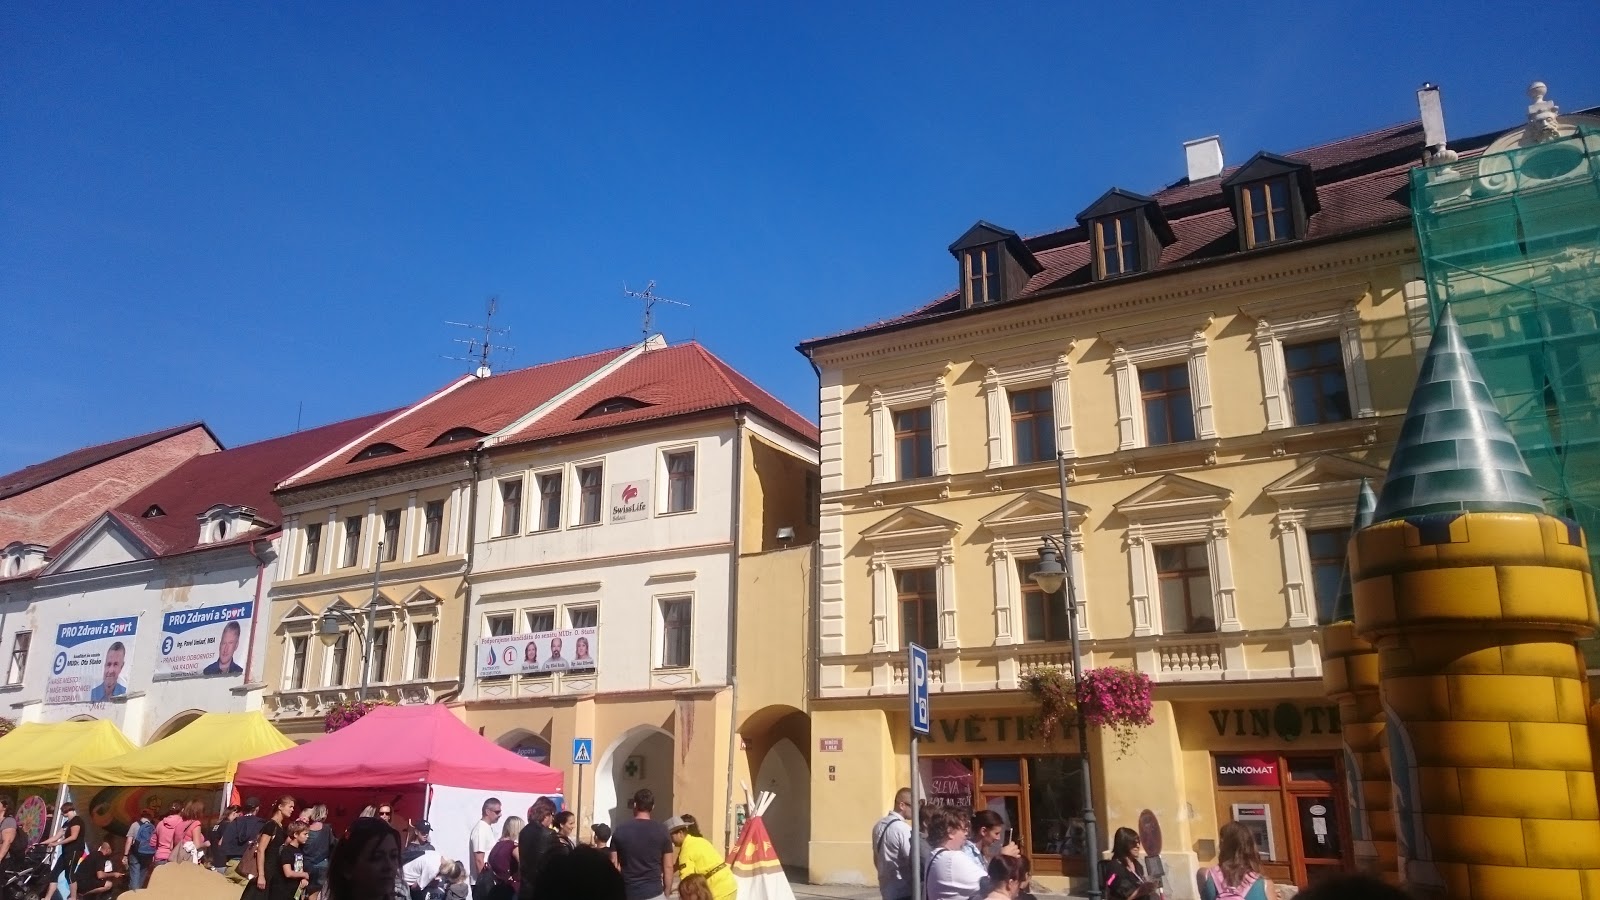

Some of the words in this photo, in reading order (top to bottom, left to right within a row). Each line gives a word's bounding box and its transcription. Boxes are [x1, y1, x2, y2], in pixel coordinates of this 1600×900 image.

[169, 614, 186, 626] PRO
[186, 609, 214, 624] Zdraví
[214, 611, 219, 620] a
[61, 626, 77, 638] PRO
[77, 623, 103, 637] Zdraví
[103, 626, 108, 635] a
[164, 639, 172, 652] 3
[55, 655, 64, 672] 9
[914, 656, 925, 704] P
[1219, 766, 1274, 775] BANKOMAT
[930, 780, 960, 795] SLEVA
